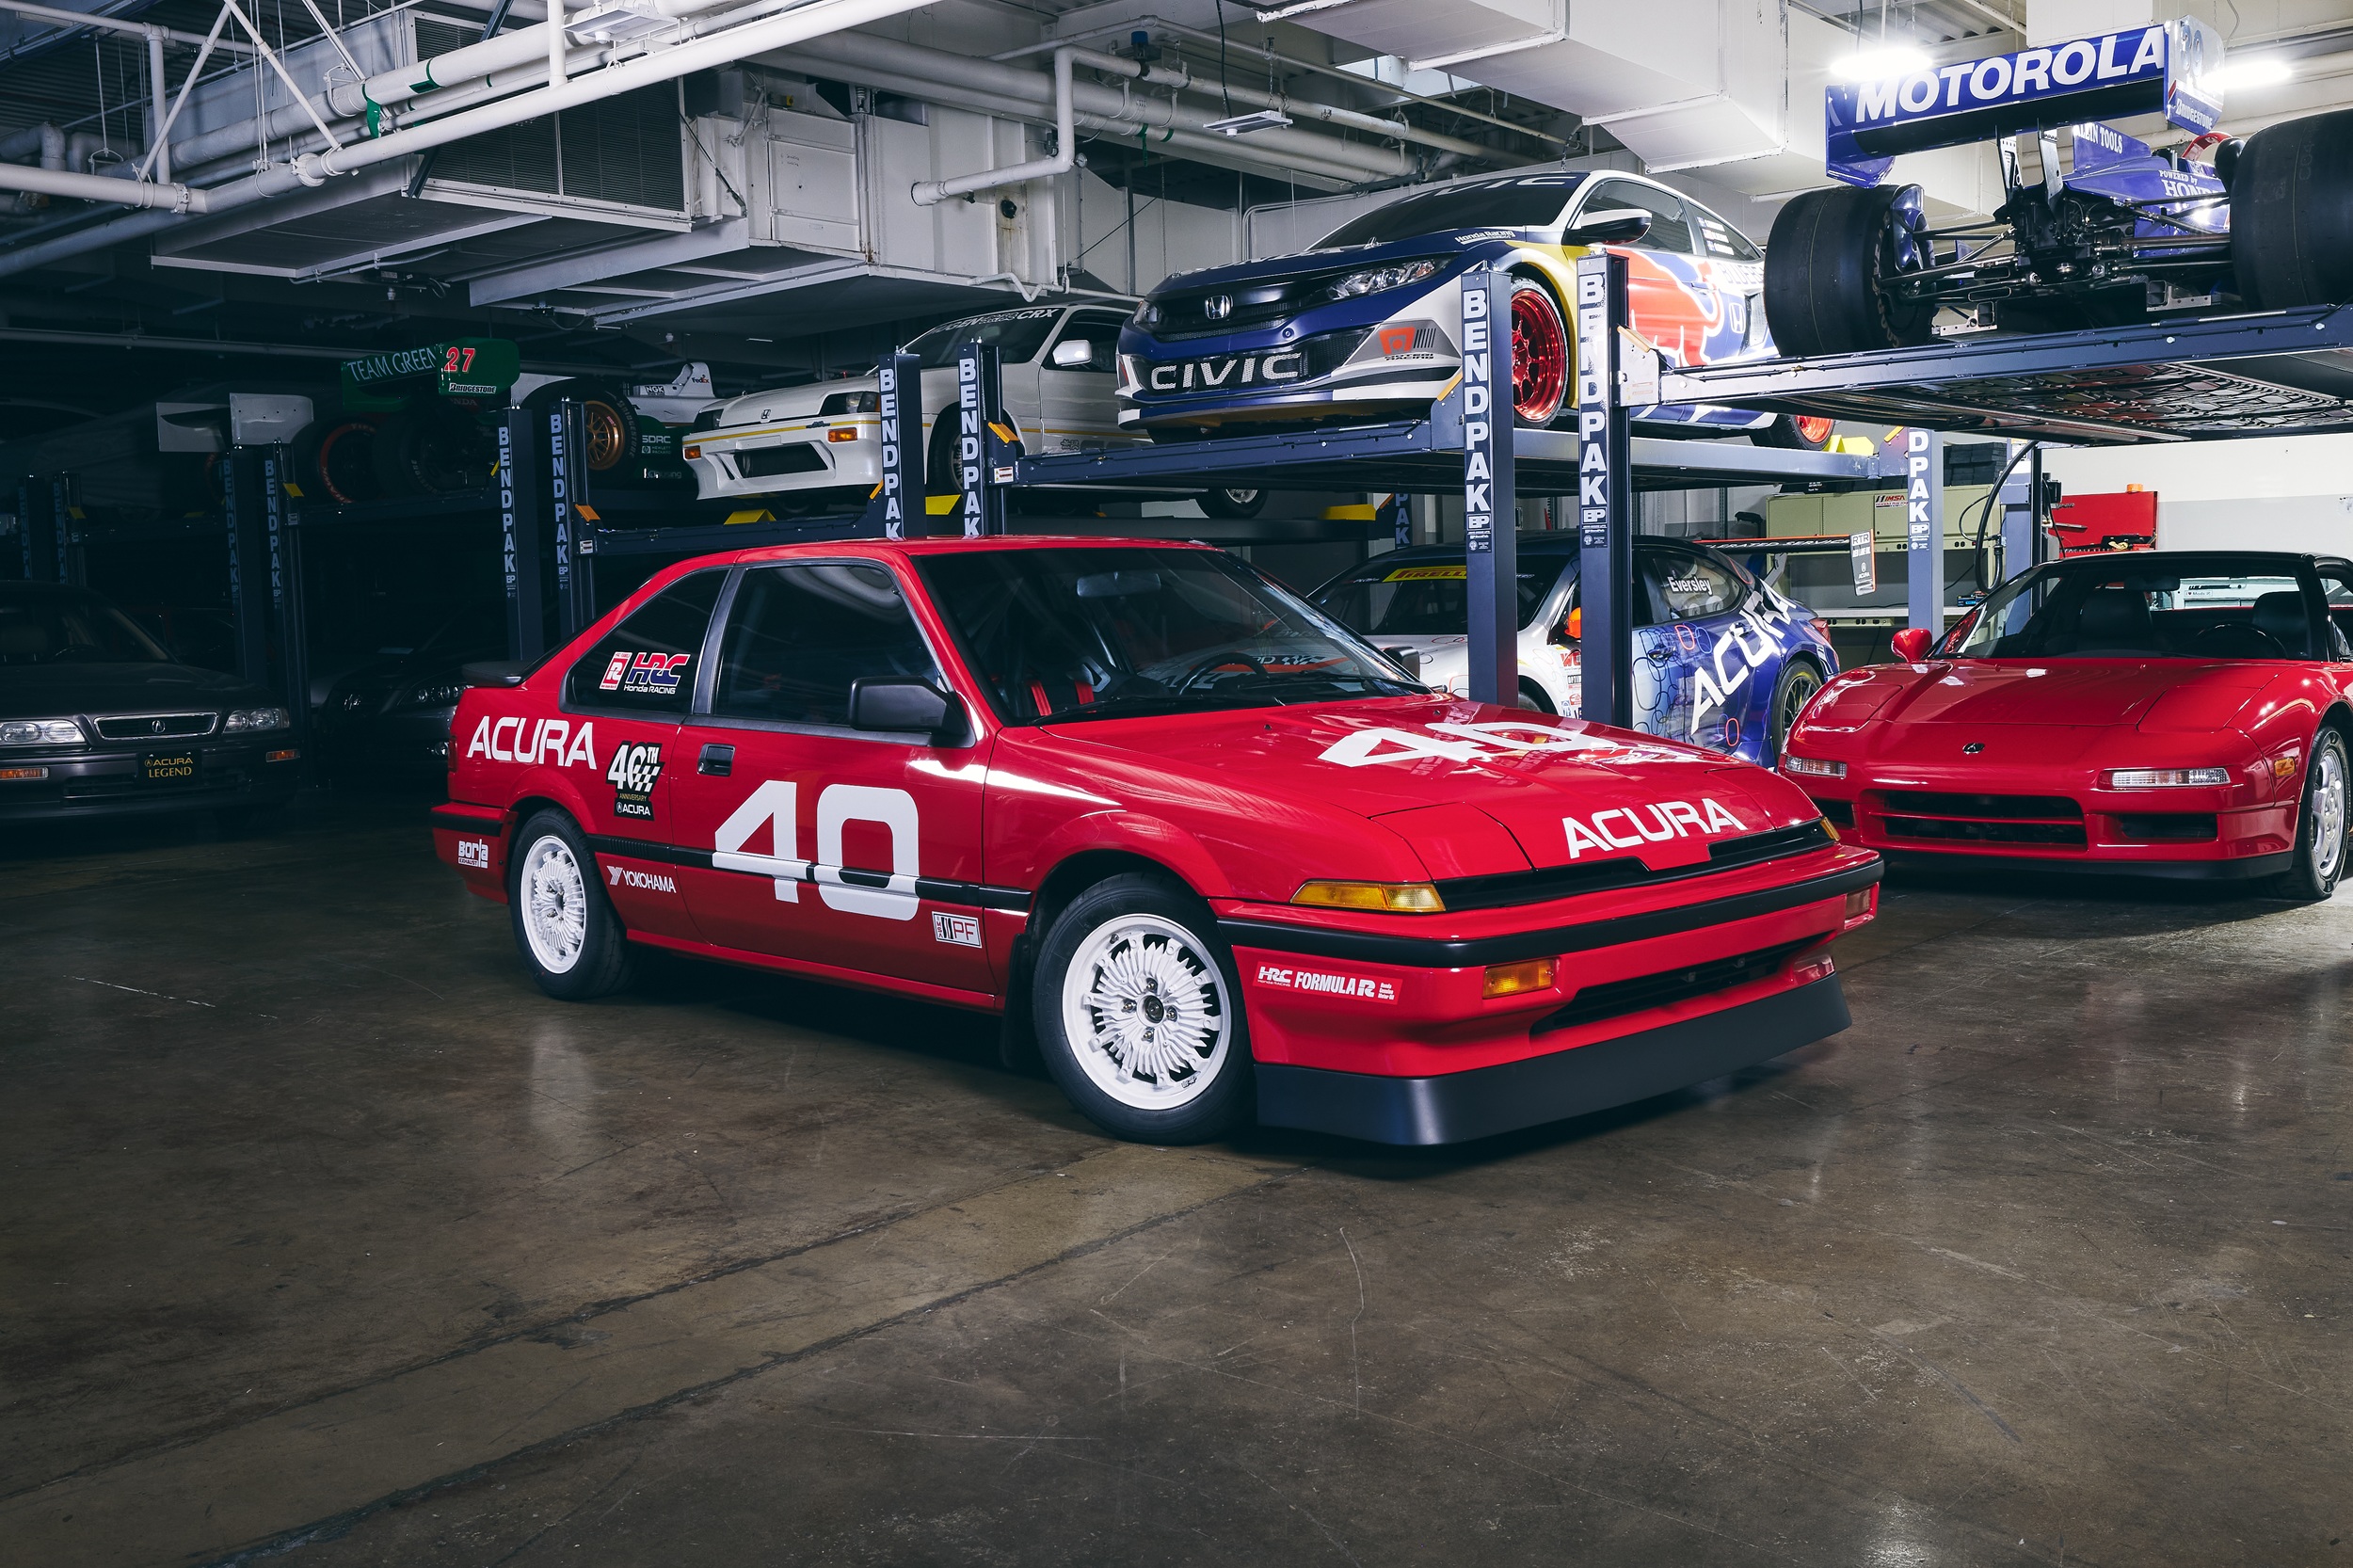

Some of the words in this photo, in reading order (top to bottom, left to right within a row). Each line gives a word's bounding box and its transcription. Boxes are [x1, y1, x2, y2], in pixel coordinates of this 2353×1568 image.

[1855, 25, 2164, 123] MOTOROLA
[2175, 99, 2213, 131] BRIDGESTONE
[2100, 127, 2123, 154] TOOLS
[2159, 170, 2189, 182] POWERED
[2190, 176, 2199, 186] by
[2161, 179, 2219, 198] HON
[1454, 232, 1486, 243] Honda
[1484, 230, 1515, 239] Racing
[1016, 308, 1060, 320] CRX
[346, 356, 393, 382] TEAM
[443, 346, 476, 374] 27
[1150, 352, 1302, 391] CIVIC
[449, 382, 496, 393] BRIDGESTONE
[645, 385, 665, 394] NGK
[692, 374, 710, 384] FedEx
[1579, 273, 1608, 506] BENDPAK
[1463, 289, 1491, 513] BENDPAK
[642, 435, 671, 444] SDRC
[959, 358, 982, 536] BENDPAK
[1909, 431, 1930, 522] DPAK
[498, 426, 517, 573] BENDPAK
[550, 414, 569, 565] BENDPAK
[1885, 494, 1906, 503] IMSA
[223, 458, 240, 584] BENDPAK
[264, 459, 281, 587] BENDPAK
[1468, 515, 1490, 529] BP
[1583, 509, 1606, 523] BP
[18, 486, 32, 580] BENDPA
[1852, 533, 1870, 545] RTR
[1911, 524, 1929, 534] BP
[1394, 567, 1466, 579] PIRELL
[1668, 576, 1713, 595] Eversley
[1691, 577, 1797, 735] ACURA
[625, 652, 691, 687] HRC
[623, 684, 648, 693] Honda
[648, 686, 677, 695] RACING
[467, 715, 598, 770] ACURA
[1319, 722, 1619, 767] 40
[149, 766, 192, 778] LEGEND
[153, 757, 194, 767] ACURA
[618, 792, 648, 802] ANNIVERSARY
[622, 803, 651, 816] ACURA
[1561, 798, 1748, 858] ACURA
[712, 779, 920, 921] 40
[622, 870, 677, 894] YOKOHAMA
[952, 920, 975, 941] PF
[1257, 966, 1293, 984] HRC
[1294, 971, 1356, 996] FORMULA
